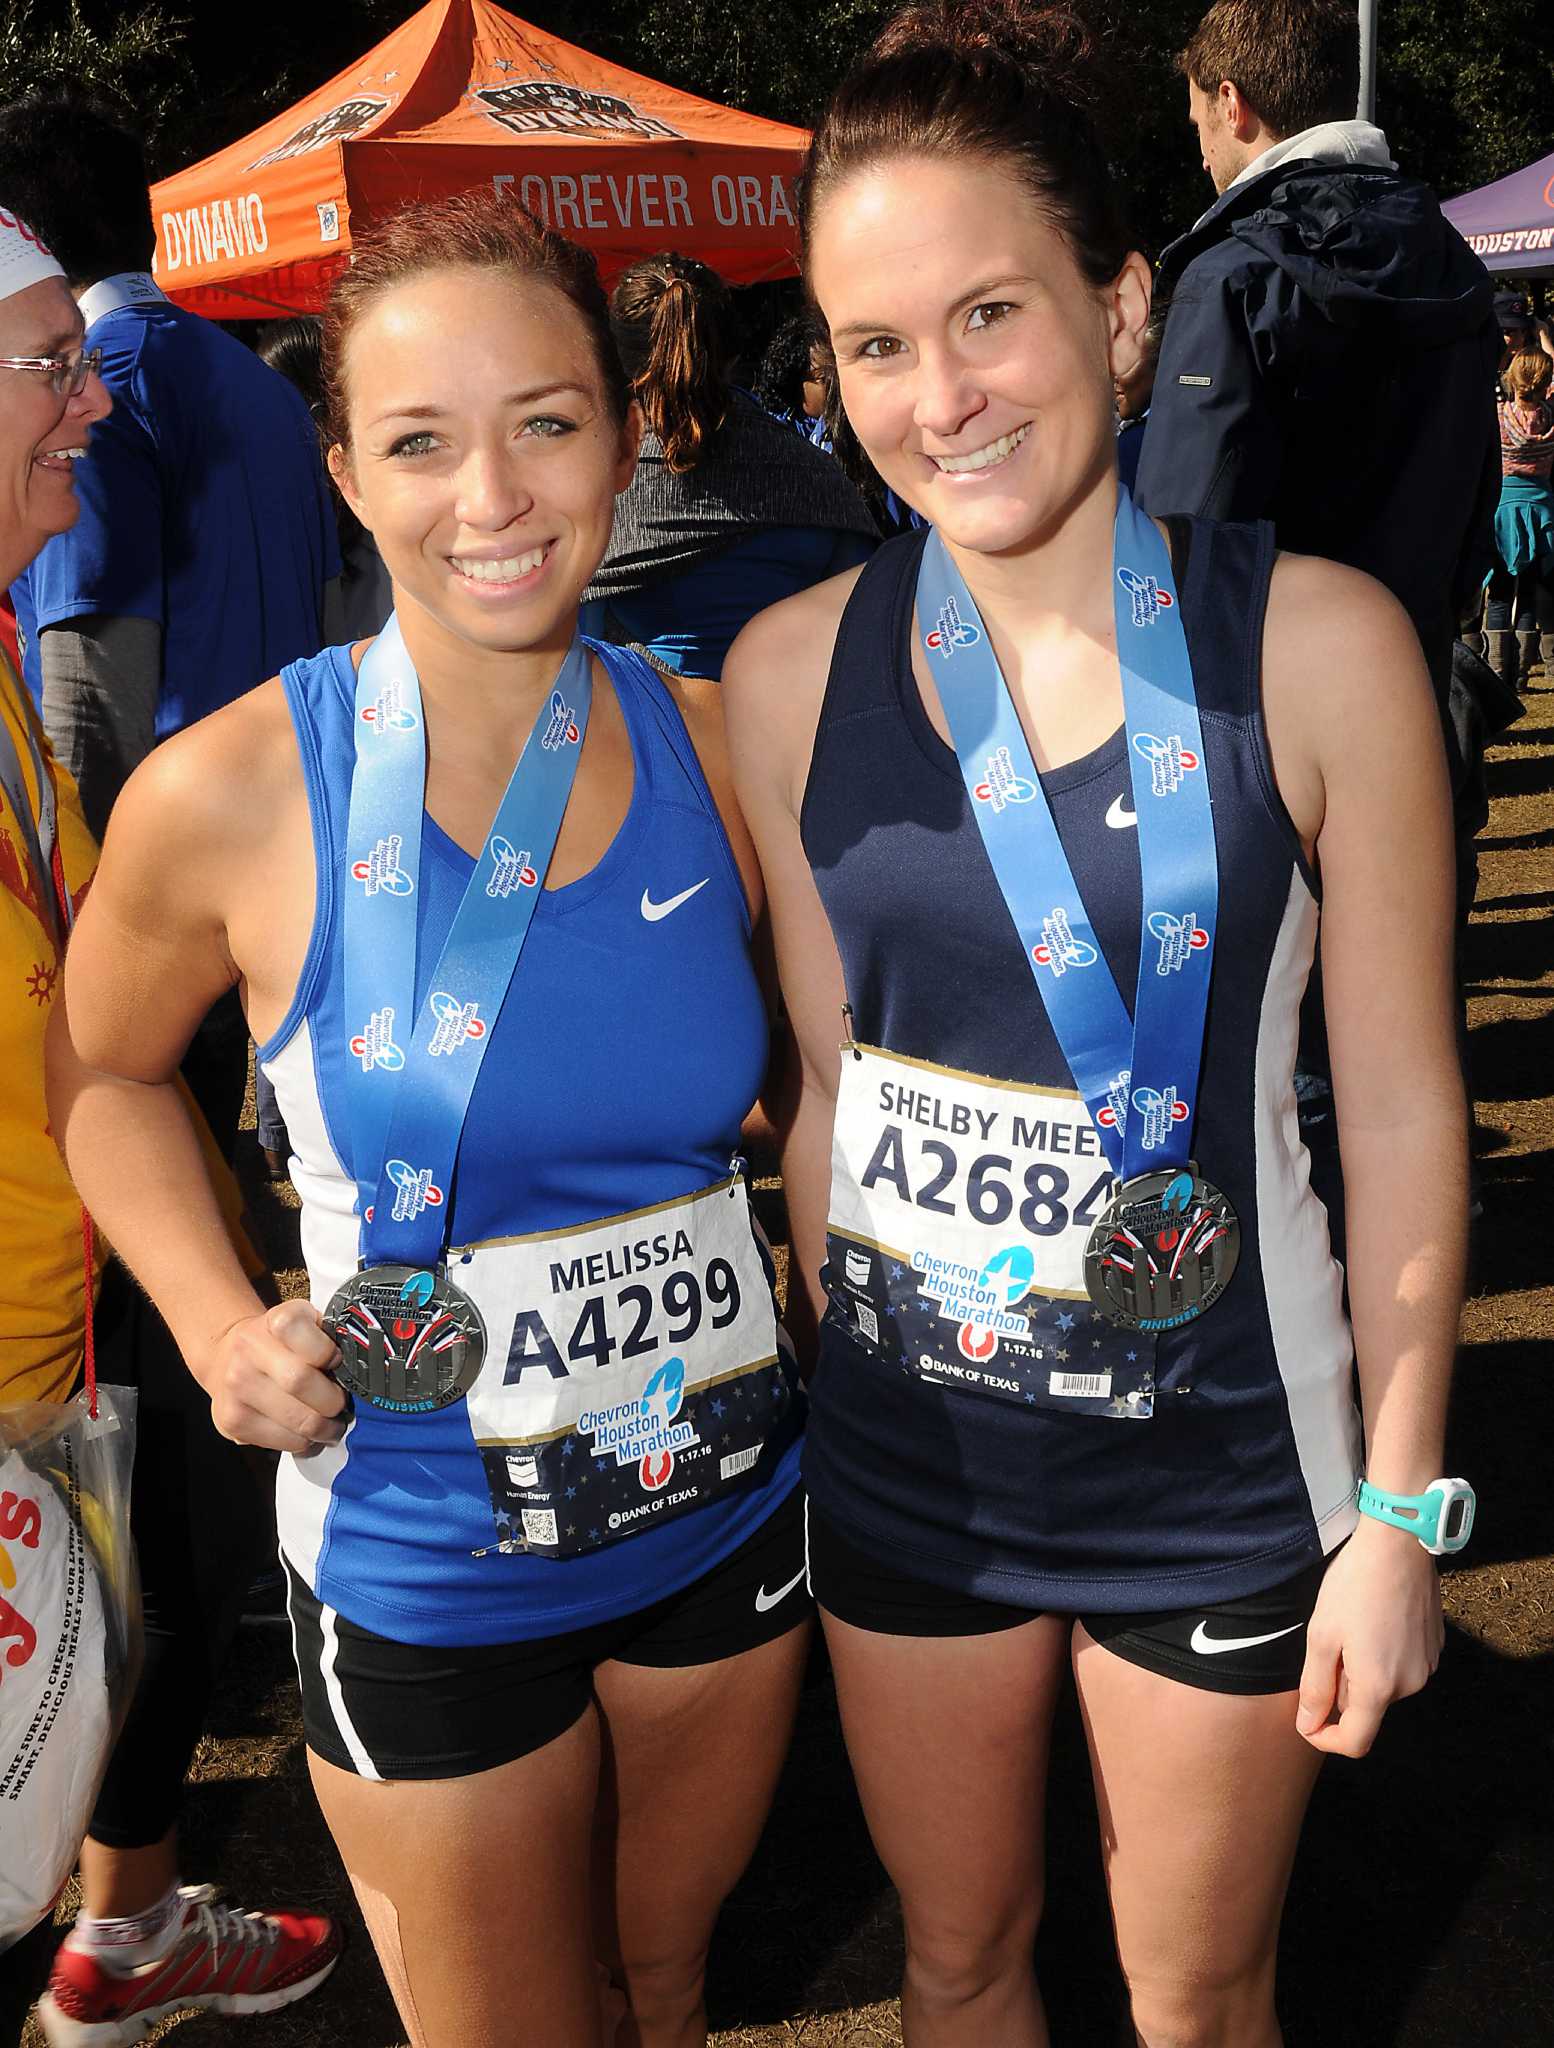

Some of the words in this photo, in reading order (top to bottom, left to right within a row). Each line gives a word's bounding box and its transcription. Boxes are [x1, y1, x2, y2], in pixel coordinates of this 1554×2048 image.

[503, 109, 677, 138] DYNAMO
[493, 175, 694, 228] FOREVER
[711, 175, 798, 227] ORA
[162, 193, 268, 271] DYNAMO
[879, 1081, 1000, 1142] SHELBY
[1011, 1116, 1106, 1158] MEE
[860, 1123, 1117, 1237] A2684
[1143, 1214, 1194, 1236] Marathon
[549, 1229, 694, 1294] MELISSA
[913, 1250, 978, 1282] Chevron
[359, 1283, 401, 1297] Chevron
[368, 1294, 413, 1309] Houston
[926, 1274, 997, 1306] Houston
[379, 1305, 433, 1322] Marathon
[502, 1257, 741, 1386] A4299
[943, 1297, 1026, 1333] Marathon
[1138, 1304, 1200, 1330] FINISHER
[1003, 1341, 1043, 1360] 1.17.16
[933, 1360, 965, 1378] BANK
[966, 1369, 981, 1383] OF
[982, 1374, 1020, 1393] TEXAS
[371, 1395, 435, 1412] FINISHER
[580, 1399, 639, 1432] Chevron
[597, 1414, 660, 1446] Houston
[617, 1423, 692, 1462] Marathon
[678, 1445, 712, 1465] 1.17.16
[620, 1502, 651, 1523] BANK
[650, 1498, 666, 1514] OF
[665, 1486, 699, 1509] TEXAS
[67, 1567, 76, 1596] OUR
[63, 1599, 73, 1629] OUT
[37, 1661, 74, 1743] DELICIOUS
[67, 1607, 82, 1658] MEALS
[76, 1556, 85, 1605] UNDER
[48, 1632, 68, 1686] CHECK
[39, 1690, 52, 1710] TO
[20, 1712, 44, 1751] SURE
[0, 1753, 24, 1798] MAKE
